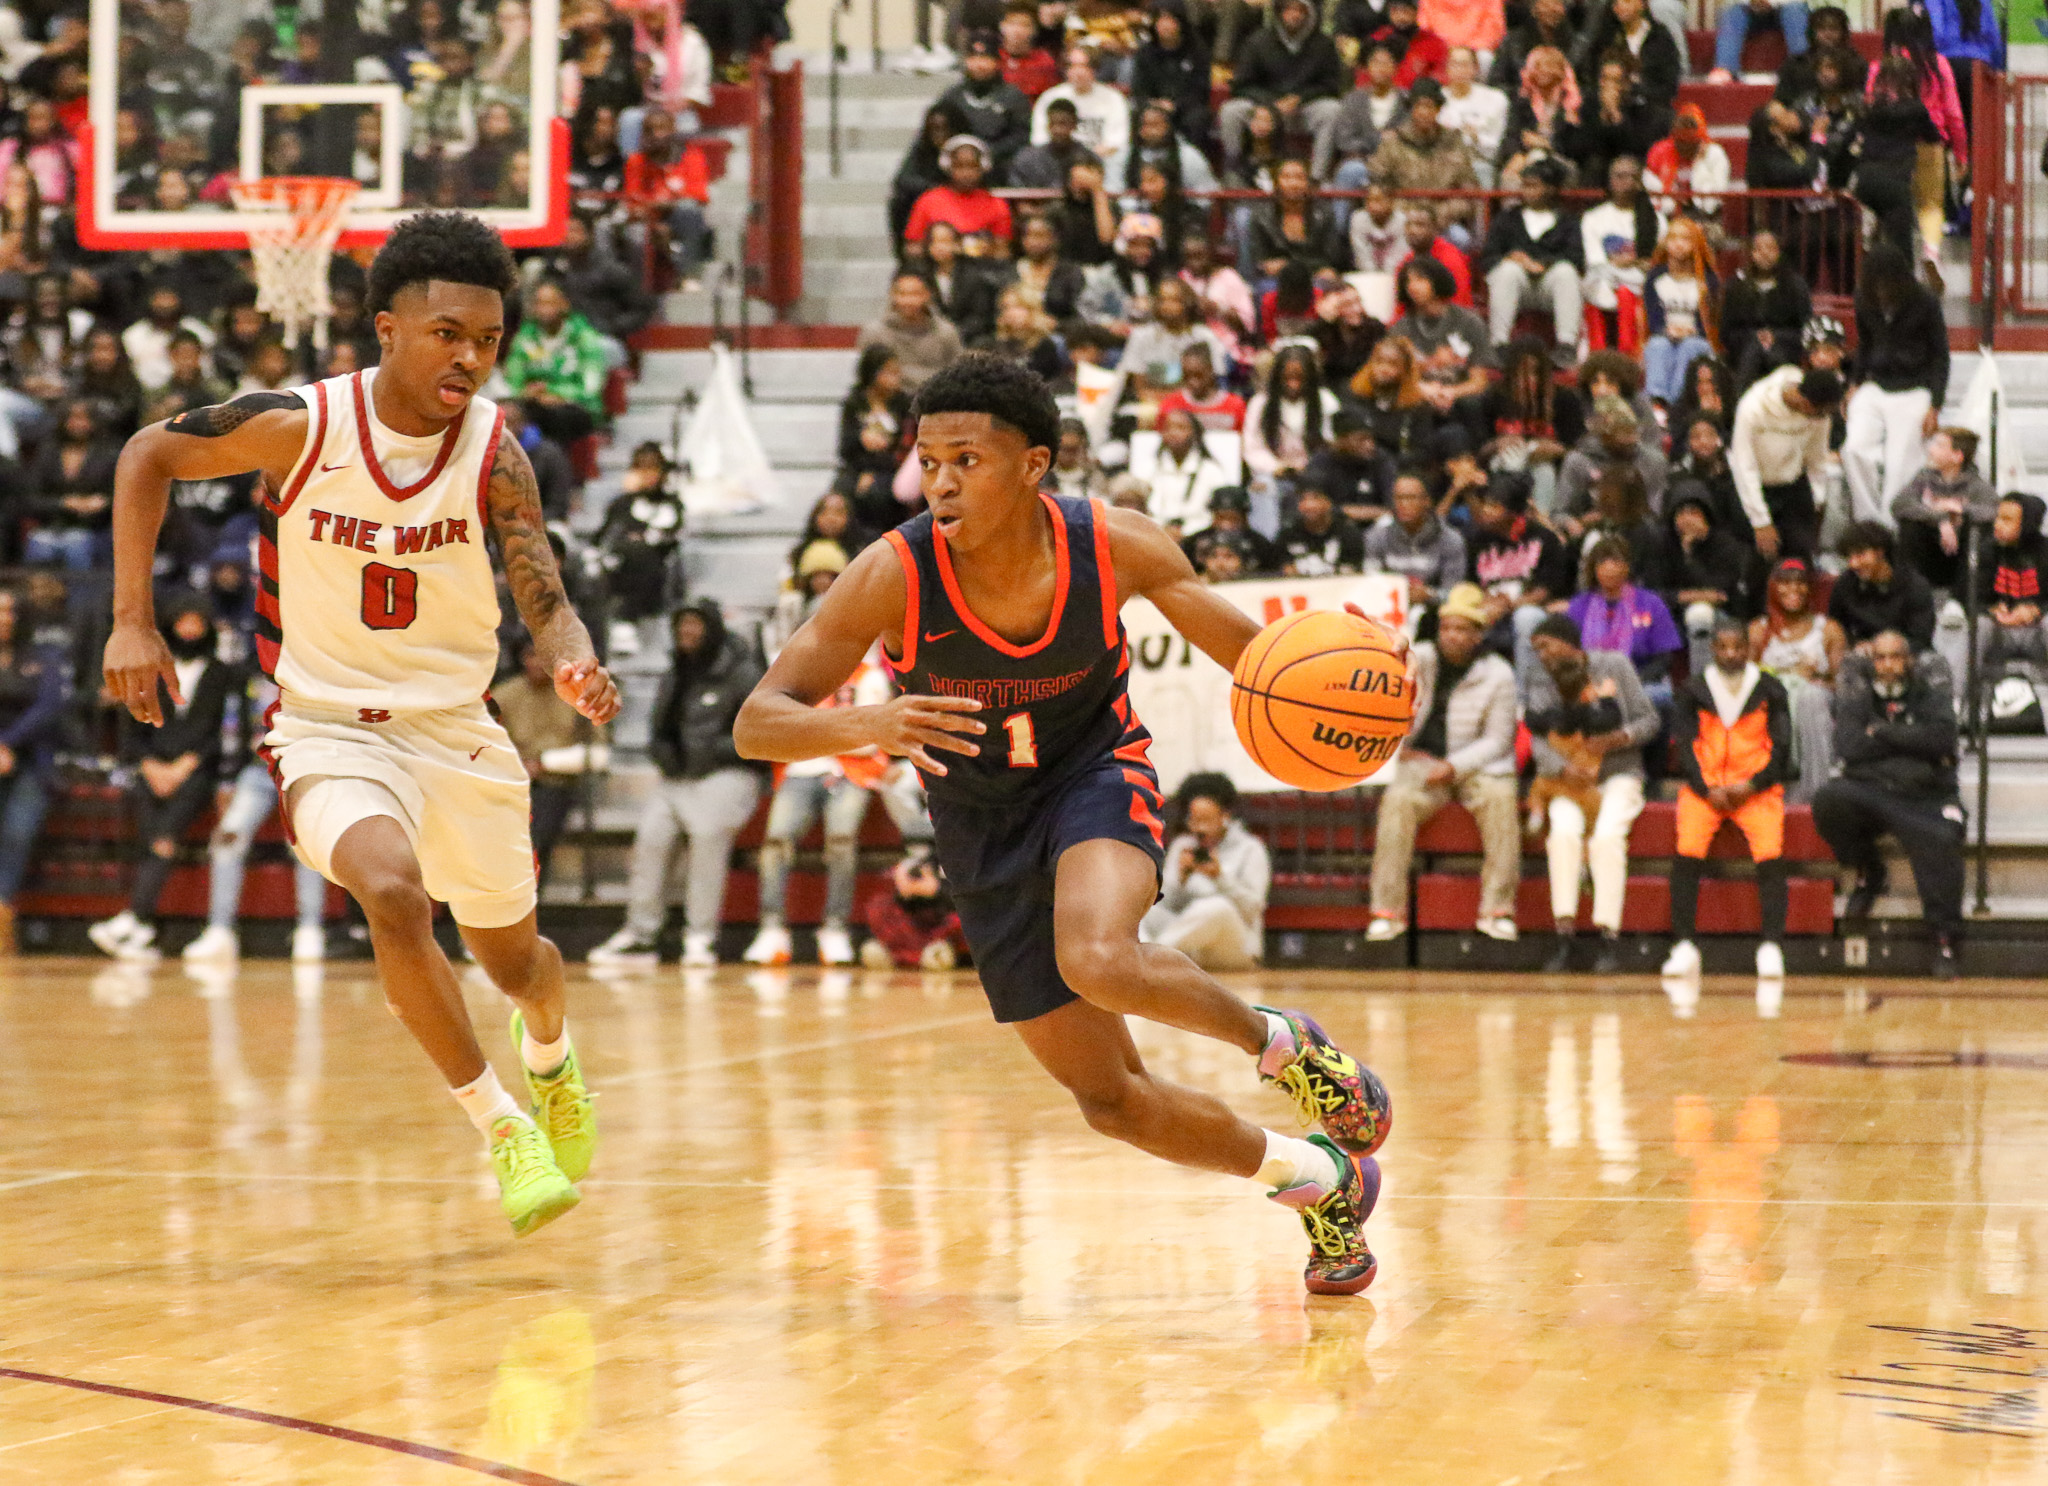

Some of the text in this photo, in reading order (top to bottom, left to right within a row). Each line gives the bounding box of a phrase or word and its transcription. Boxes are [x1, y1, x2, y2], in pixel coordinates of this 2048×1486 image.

[309, 508, 470, 556] THE WAR
[361, 561, 418, 631] 0
[1002, 711, 1039, 768] 1
